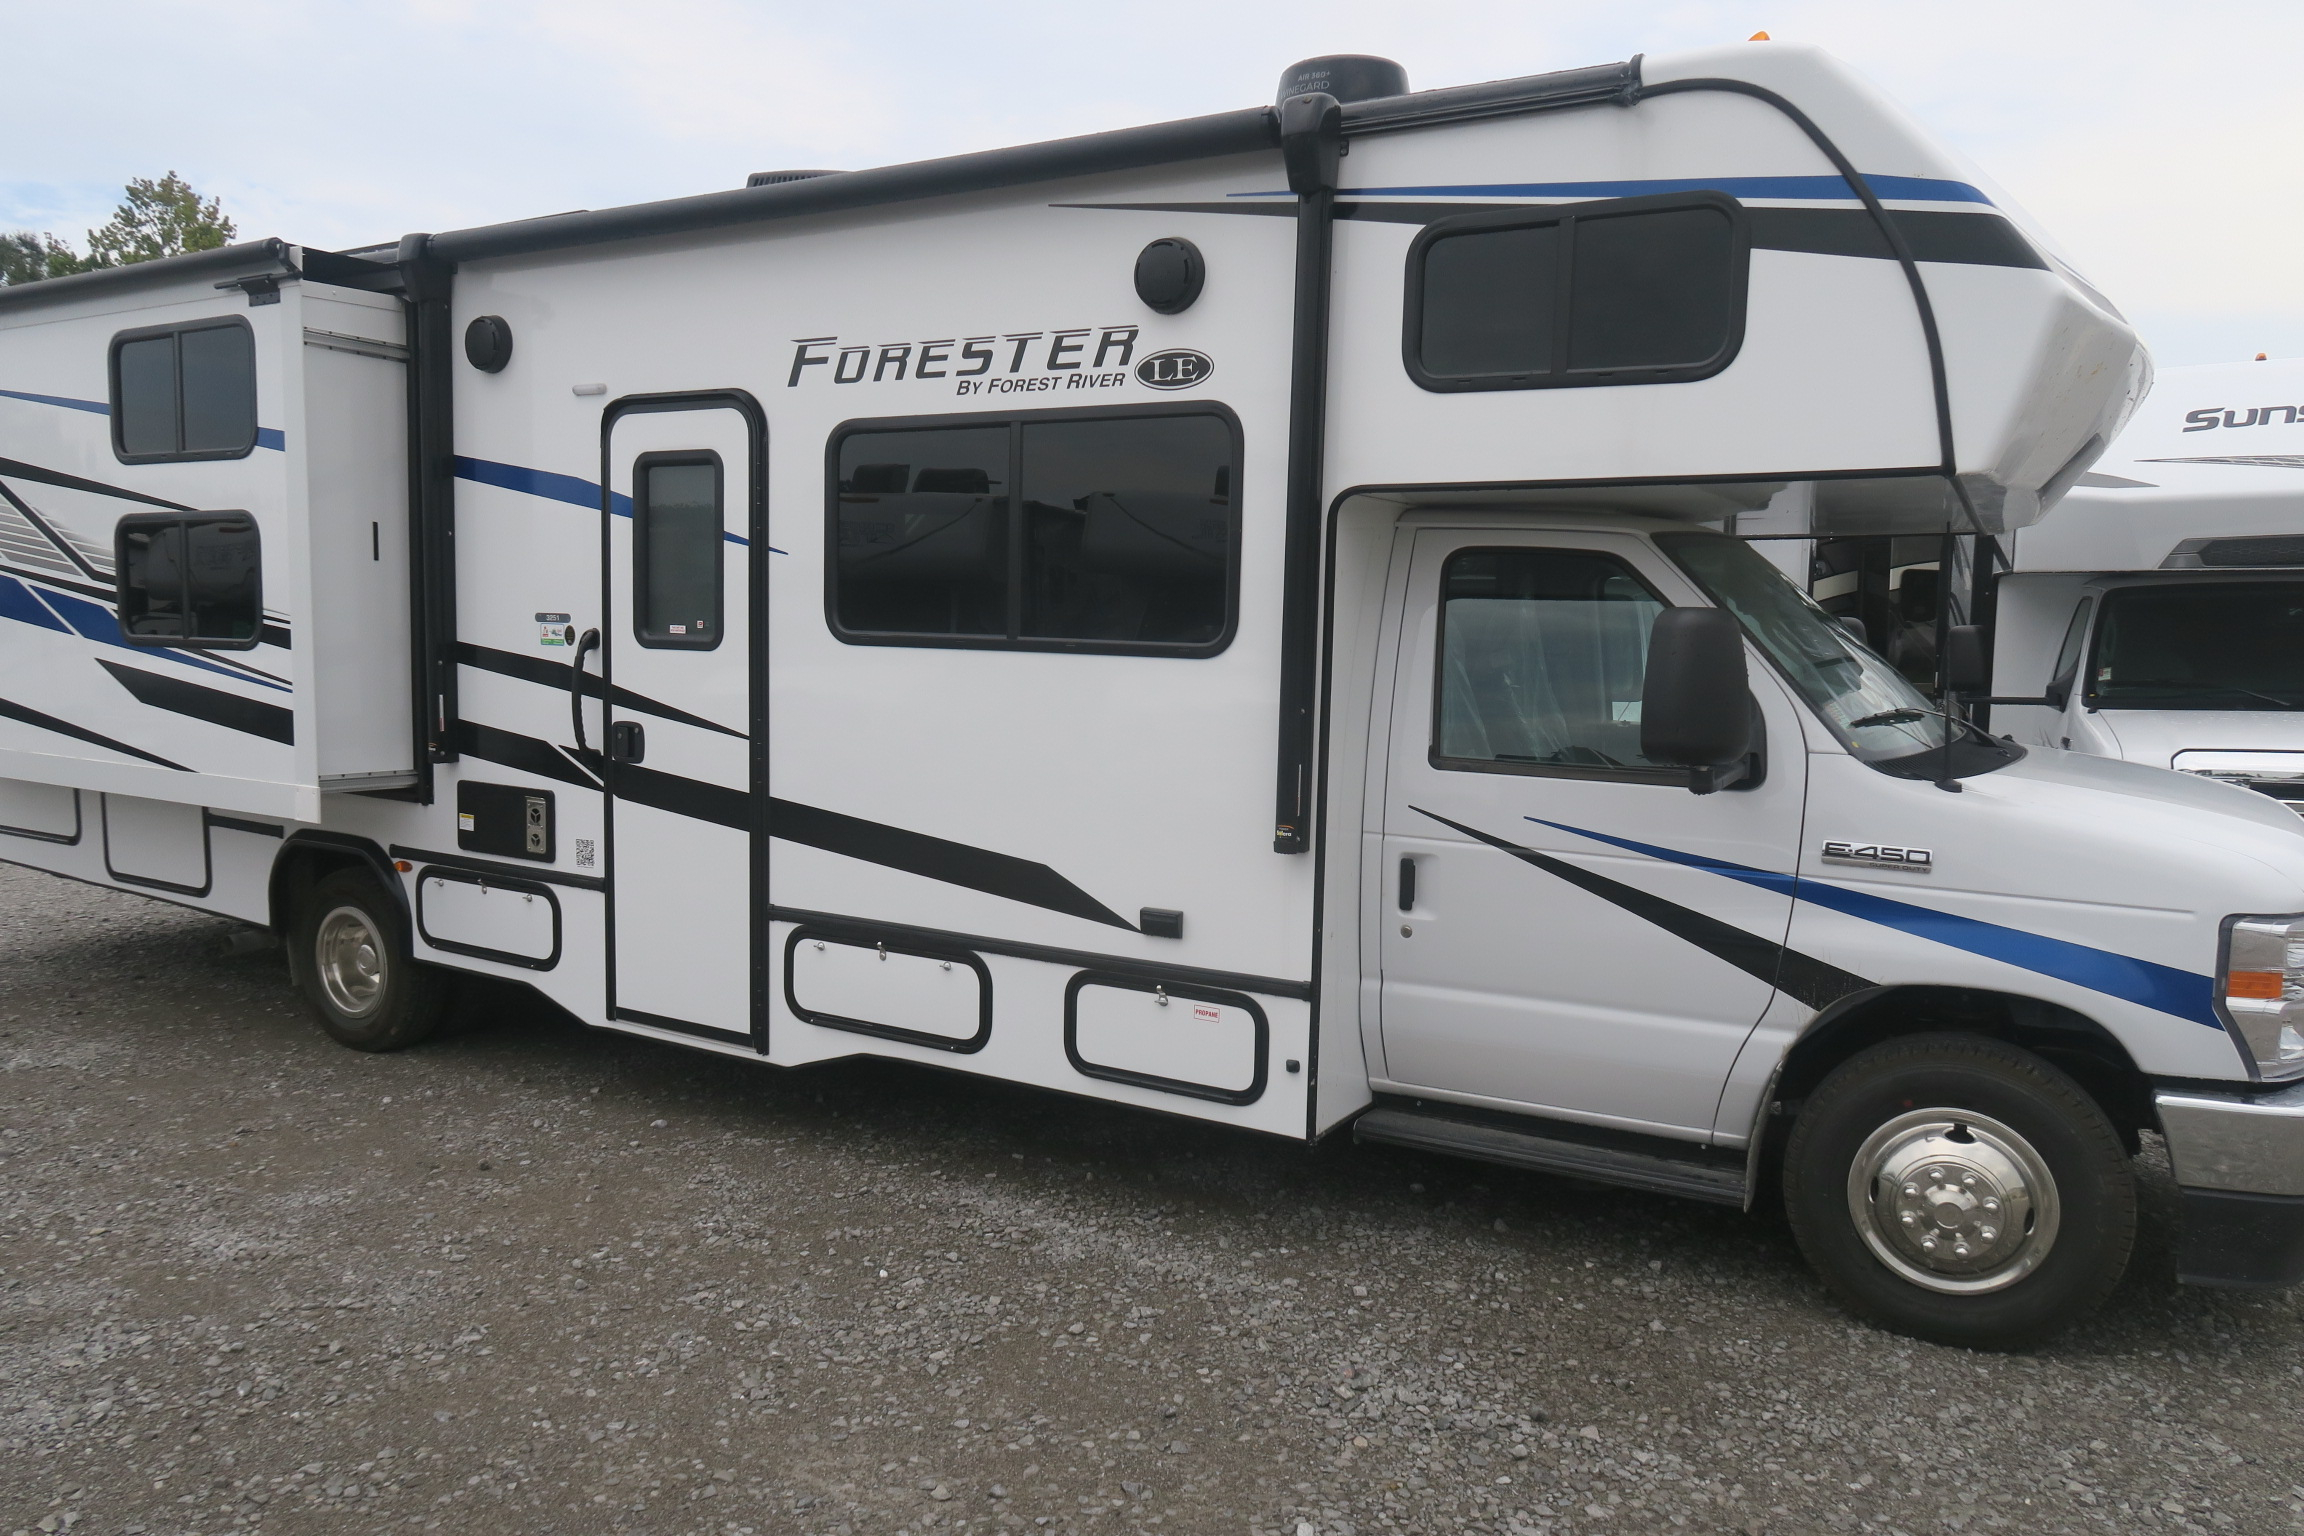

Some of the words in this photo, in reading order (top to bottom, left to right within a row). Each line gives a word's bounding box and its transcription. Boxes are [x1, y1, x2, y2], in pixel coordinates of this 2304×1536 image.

[1297, 73, 1310, 82] AIR
[1280, 80, 1330, 99] WINEGARD
[787, 325, 1139, 387] FORESTER
[1149, 356, 1200, 382] LE
[987, 374, 1062, 394] FOREST
[1066, 373, 1126, 390] RIVER
[1195, 1008, 1219, 1019] PROPANE
